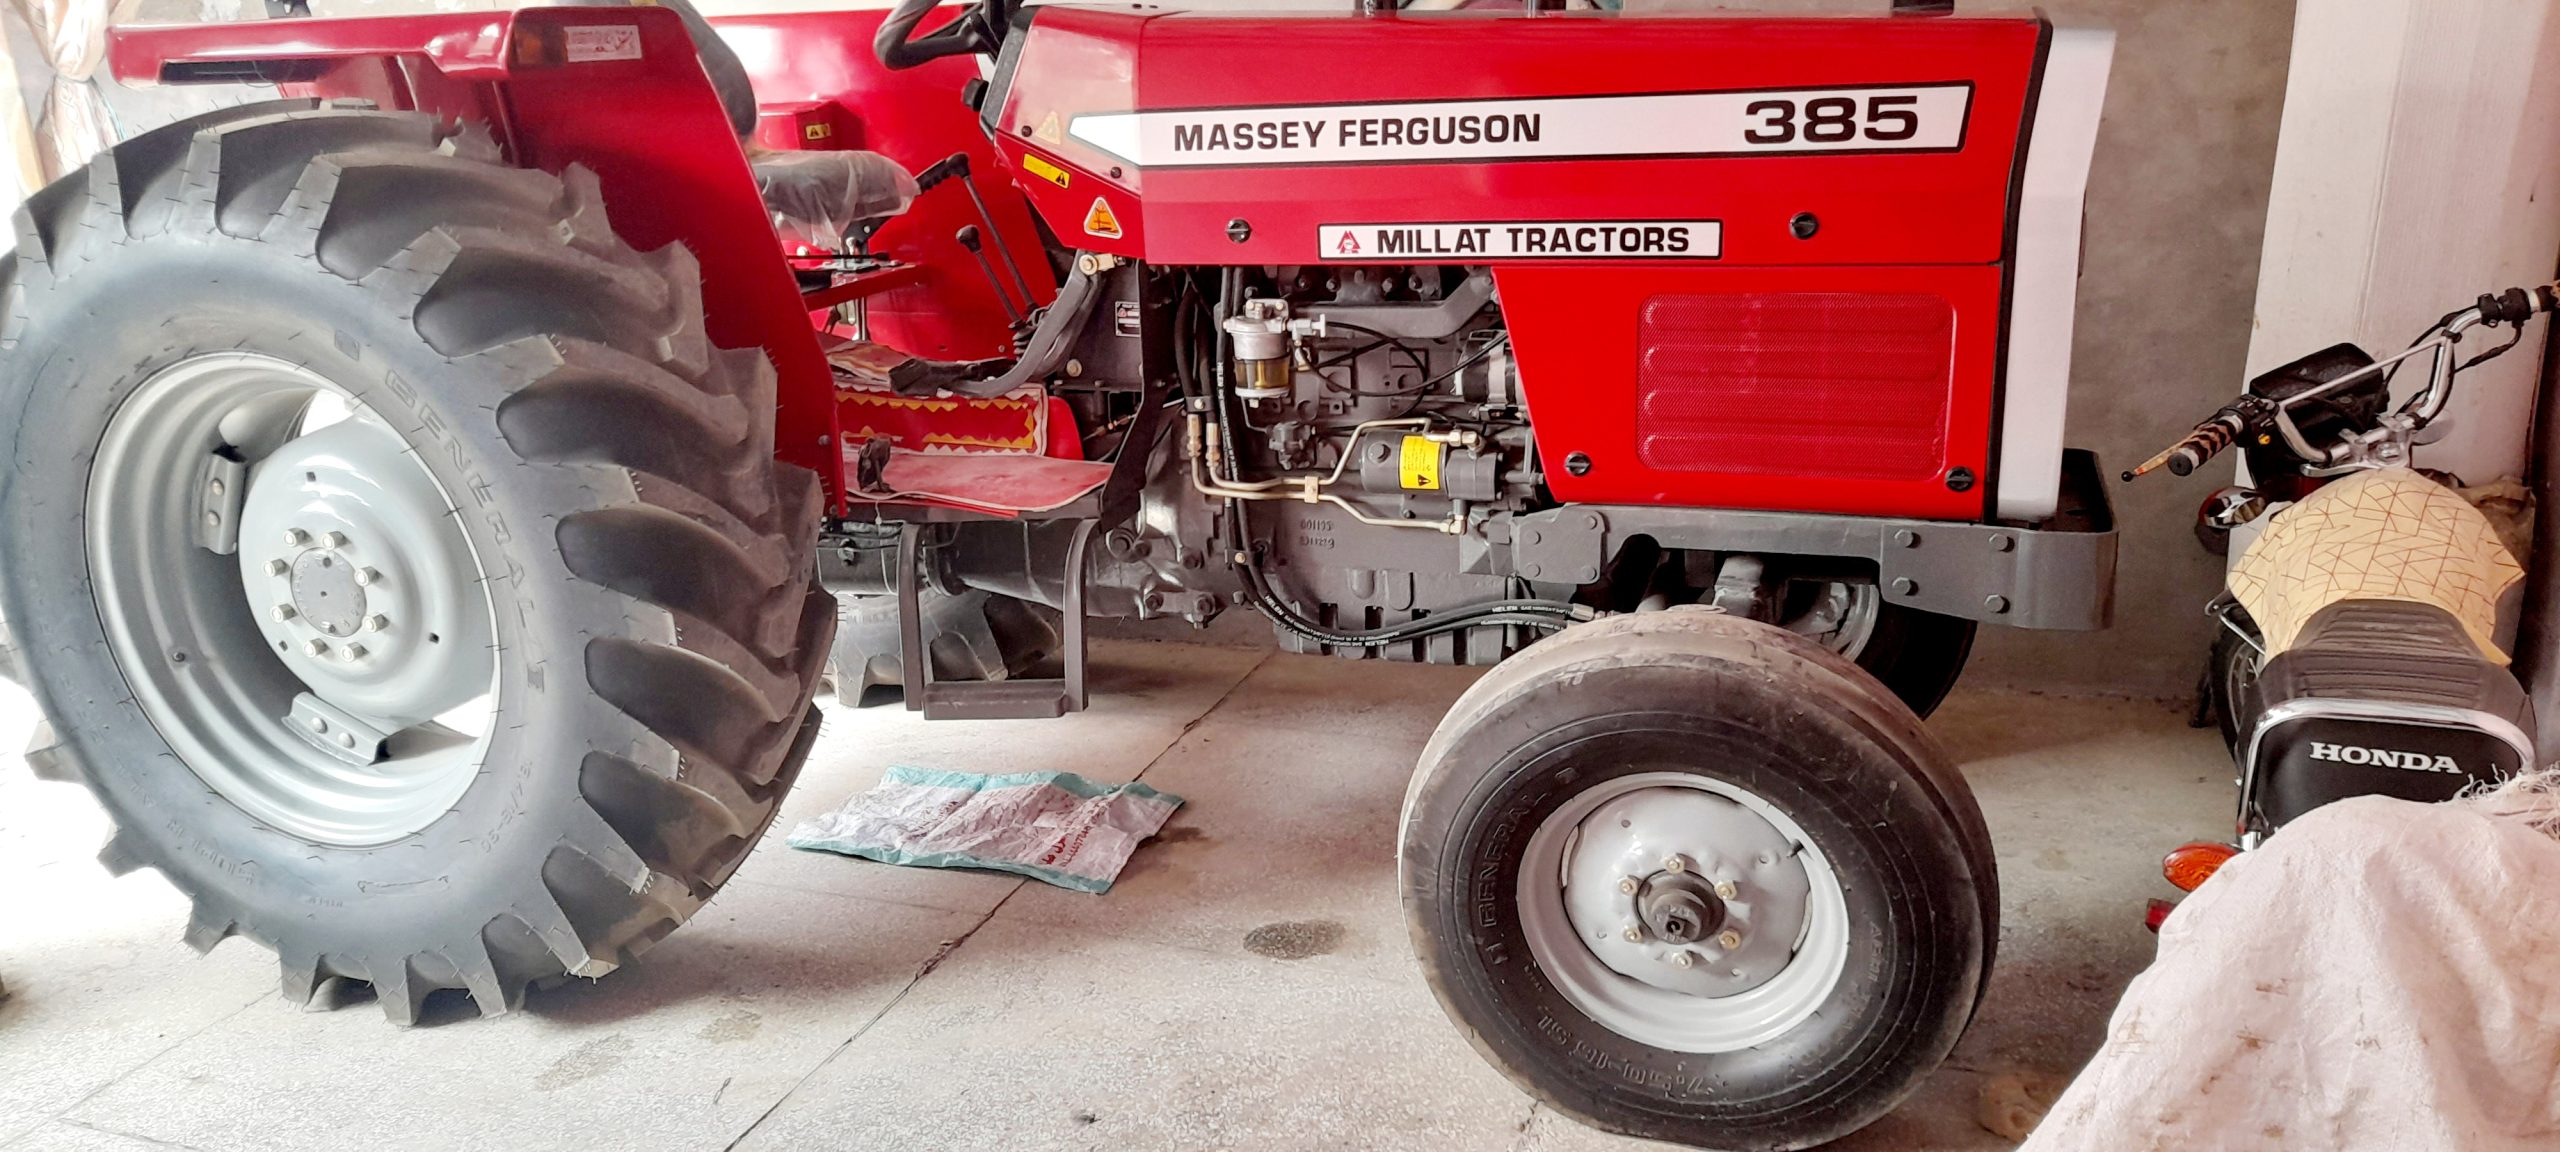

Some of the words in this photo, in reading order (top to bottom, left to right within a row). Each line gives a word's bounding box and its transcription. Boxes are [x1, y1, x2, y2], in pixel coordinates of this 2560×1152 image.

[1174, 120, 1326, 152] MASSEY
[1339, 113, 1541, 147] FERGUSON
[1744, 95, 1918, 145] 385
[1377, 228, 1491, 254] MILLAT
[1506, 226, 1690, 253] TRACTORS
[384, 368, 535, 629] GENERAL
[2309, 741, 2463, 774] HONDA
[1478, 792, 1548, 928] GENERAL
